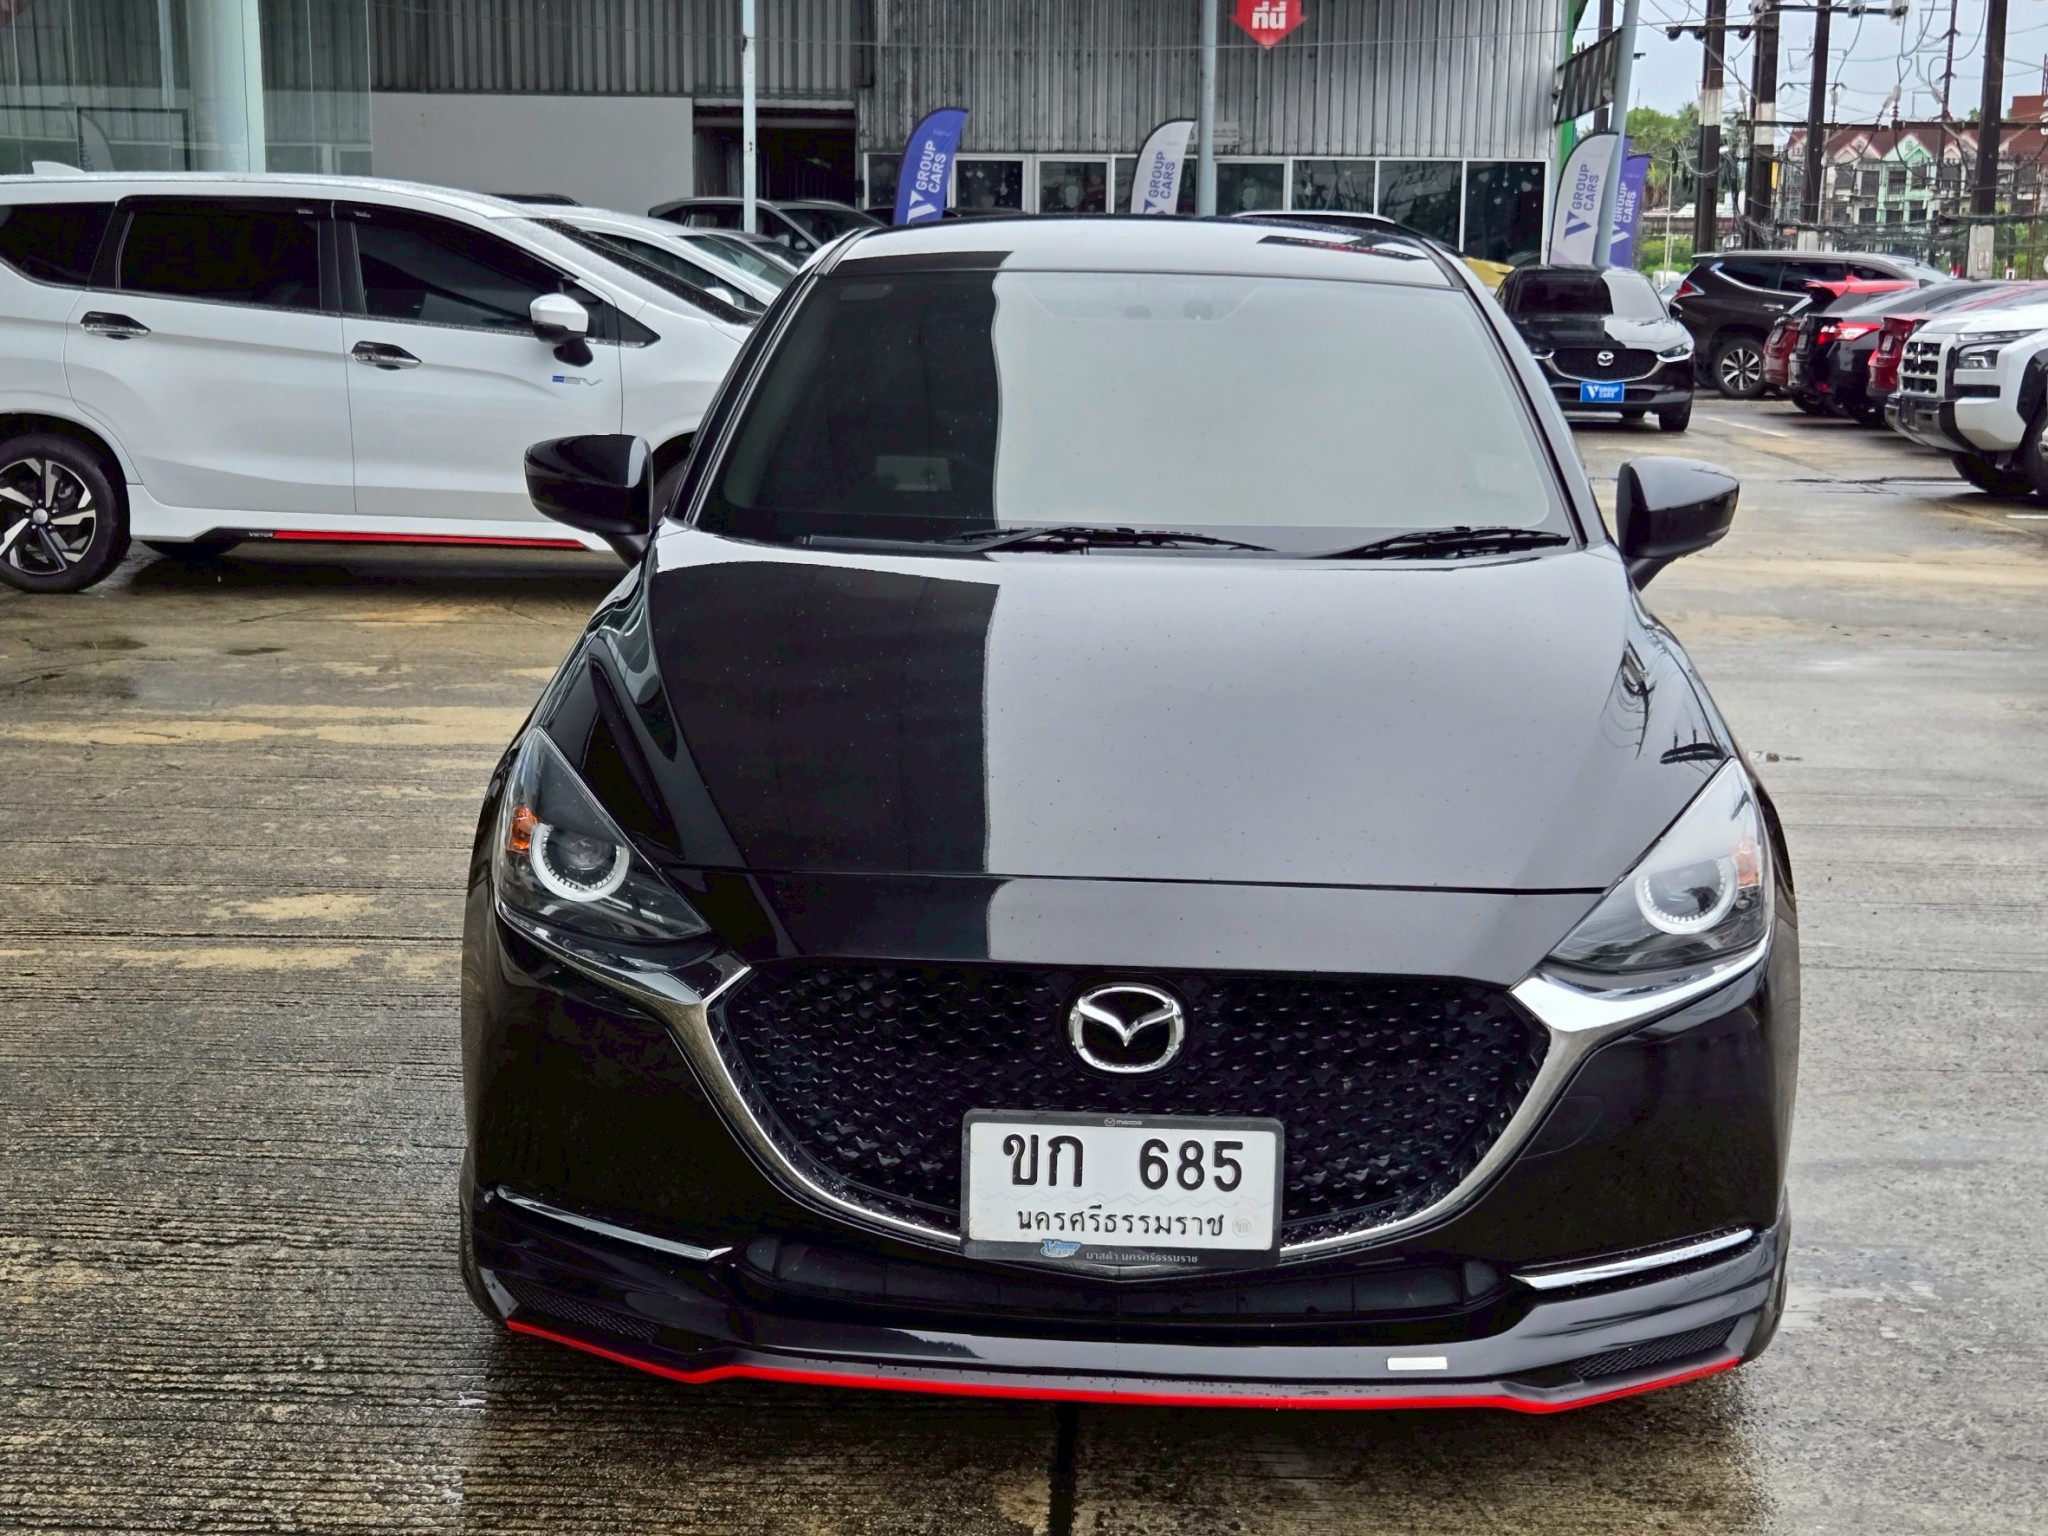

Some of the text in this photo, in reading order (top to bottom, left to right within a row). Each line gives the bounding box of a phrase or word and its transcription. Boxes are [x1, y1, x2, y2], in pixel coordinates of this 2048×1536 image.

[915, 140, 936, 191] GROUP
[928, 153, 947, 193] CARS
[1148, 151, 1166, 198] GROUP
[1160, 162, 1176, 200] CARS
[1572, 163, 1590, 210] GROUP
[1583, 174, 1600, 211] CARS
[1622, 191, 1637, 223] CARS
[1002, 1133, 1244, 1192] ขก 685
[1017, 1203, 1225, 1237] นครศรีธรรมราช
